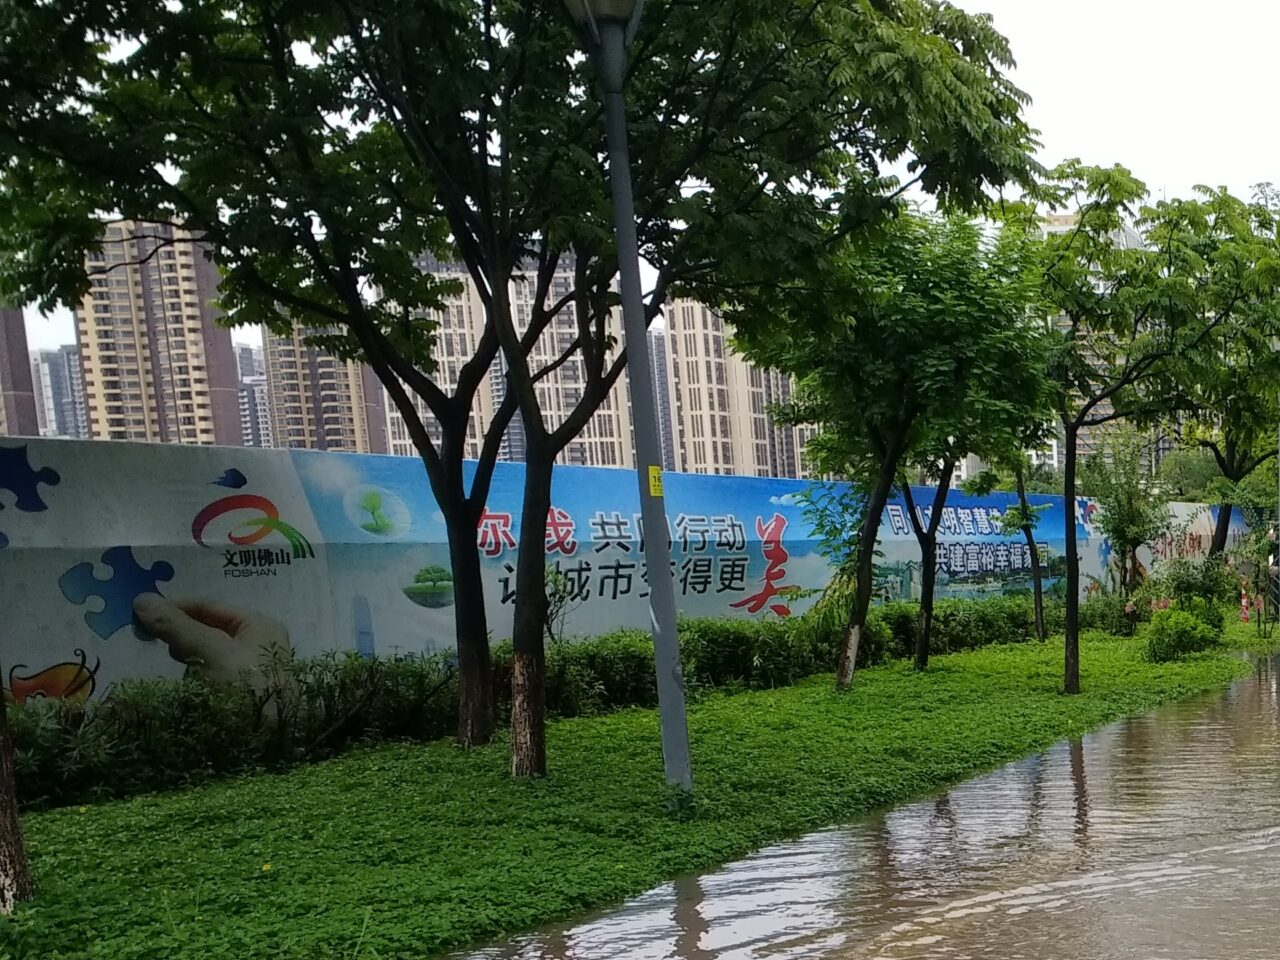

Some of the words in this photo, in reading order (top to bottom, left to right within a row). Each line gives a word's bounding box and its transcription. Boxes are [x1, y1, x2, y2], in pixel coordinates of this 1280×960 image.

[477, 507, 746, 556] 你我共行动
[220, 548, 292, 568] 文明佛山
[224, 568, 277, 578] FOSHAN
[498, 556, 748, 604] 城市得更
